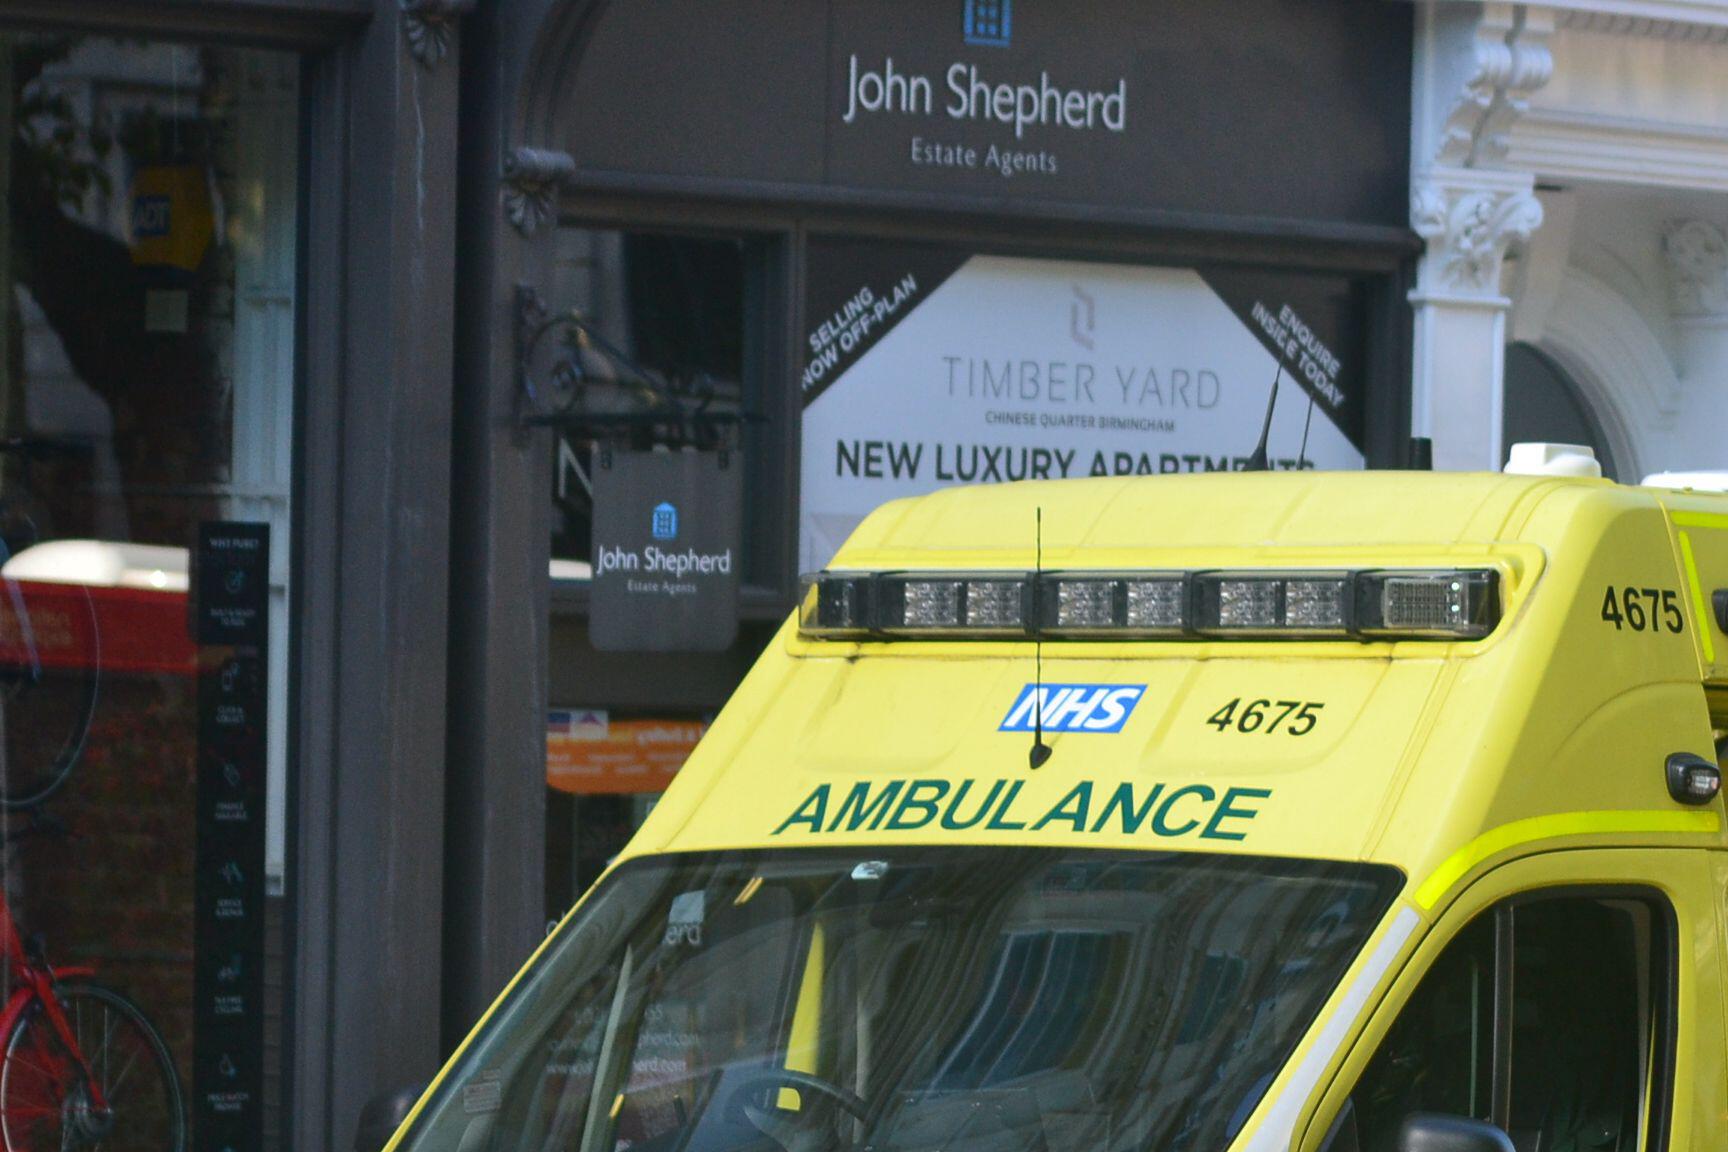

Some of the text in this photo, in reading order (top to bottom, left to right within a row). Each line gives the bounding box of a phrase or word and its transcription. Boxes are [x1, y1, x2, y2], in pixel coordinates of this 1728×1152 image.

[843, 54, 1127, 139] John Shepherd
[911, 137, 1057, 175] Estate Agents
[801, 273, 917, 391] NOW OFF-PLAN
[809, 286, 874, 352] SELLING
[1279, 303, 1342, 379] ENQUIRE
[1252, 301, 1345, 406] INSIDE TODAY
[943, 357, 1221, 408] TIMBER YARD
[985, 411, 1175, 432] CHINESE QUARTER BIRMINGHAM
[836, 440, 922, 480] NEW
[936, 445, 1075, 482] LUXURY
[597, 546, 731, 578] John Shepherd
[627, 579, 697, 598] Estate Agents
[1601, 586, 1683, 634] 4675
[1004, 685, 1137, 729] NHS
[1206, 698, 1323, 735] 4675
[778, 779, 1273, 841] AMBULANCE
